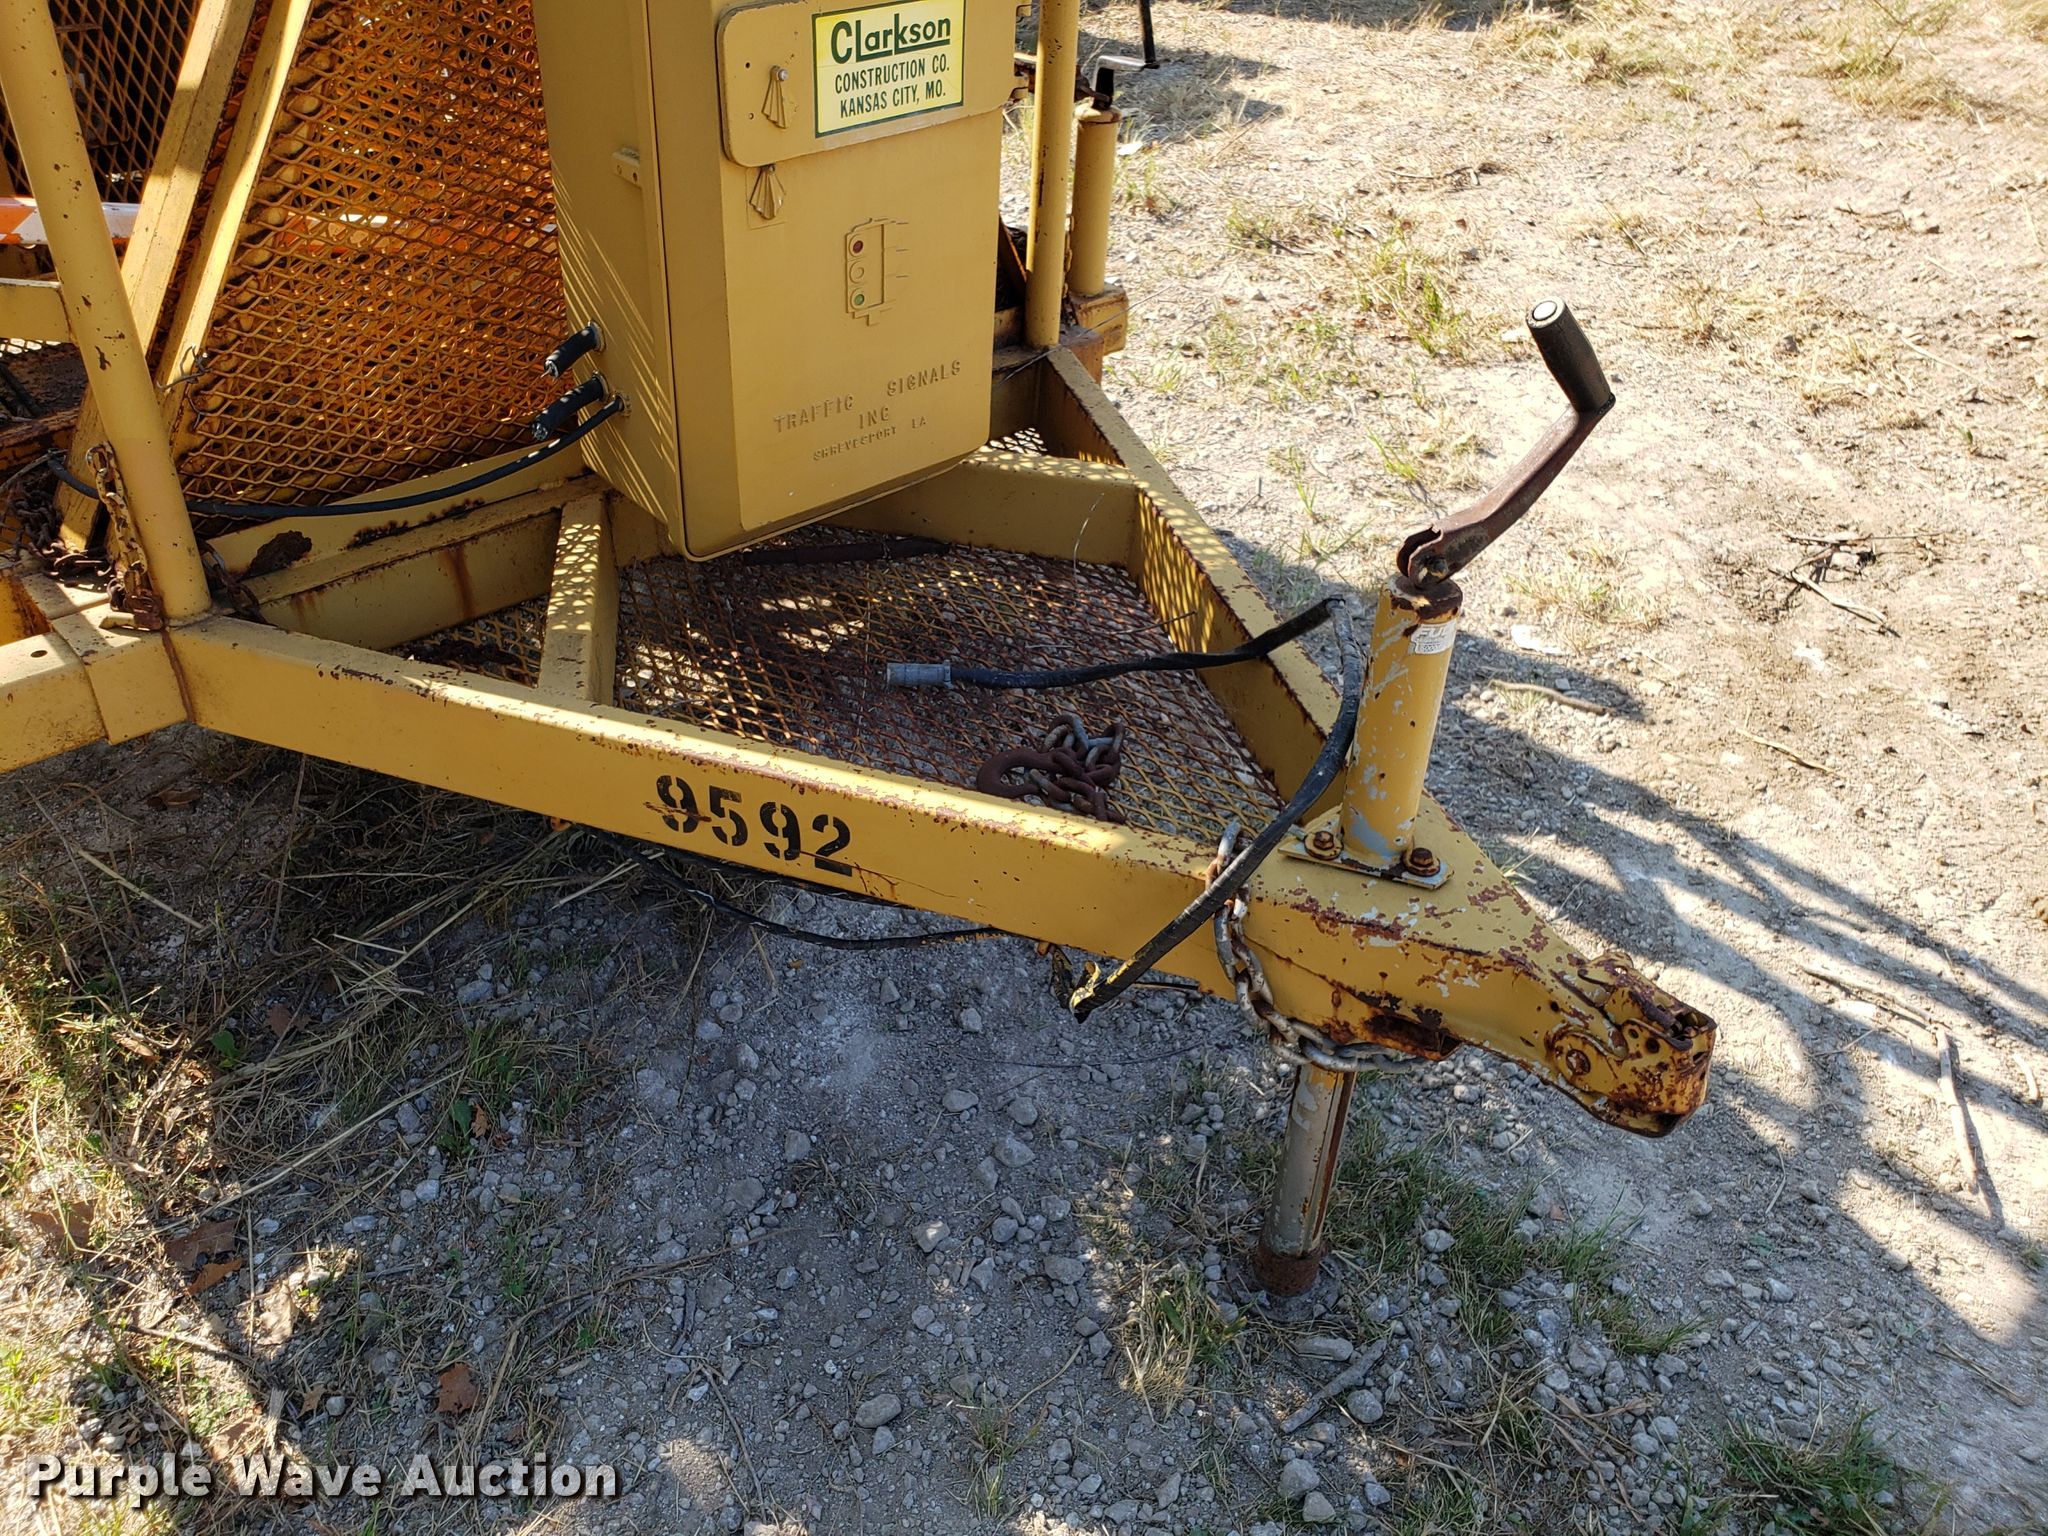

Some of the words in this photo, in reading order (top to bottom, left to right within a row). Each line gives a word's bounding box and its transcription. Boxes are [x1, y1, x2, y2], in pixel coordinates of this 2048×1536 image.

[831, 13, 951, 64] Clarkson
[835, 58, 925, 94] CONSTRUCTION
[932, 53, 950, 74] CO.
[840, 91, 888, 118] KANSAS
[892, 85, 920, 107] CITY,
[925, 79, 946, 100] MO.
[774, 394, 854, 433] TRAFFIC
[886, 359, 961, 397] SIGNALS
[859, 406, 890, 430] INC
[655, 774, 853, 878] 9592
